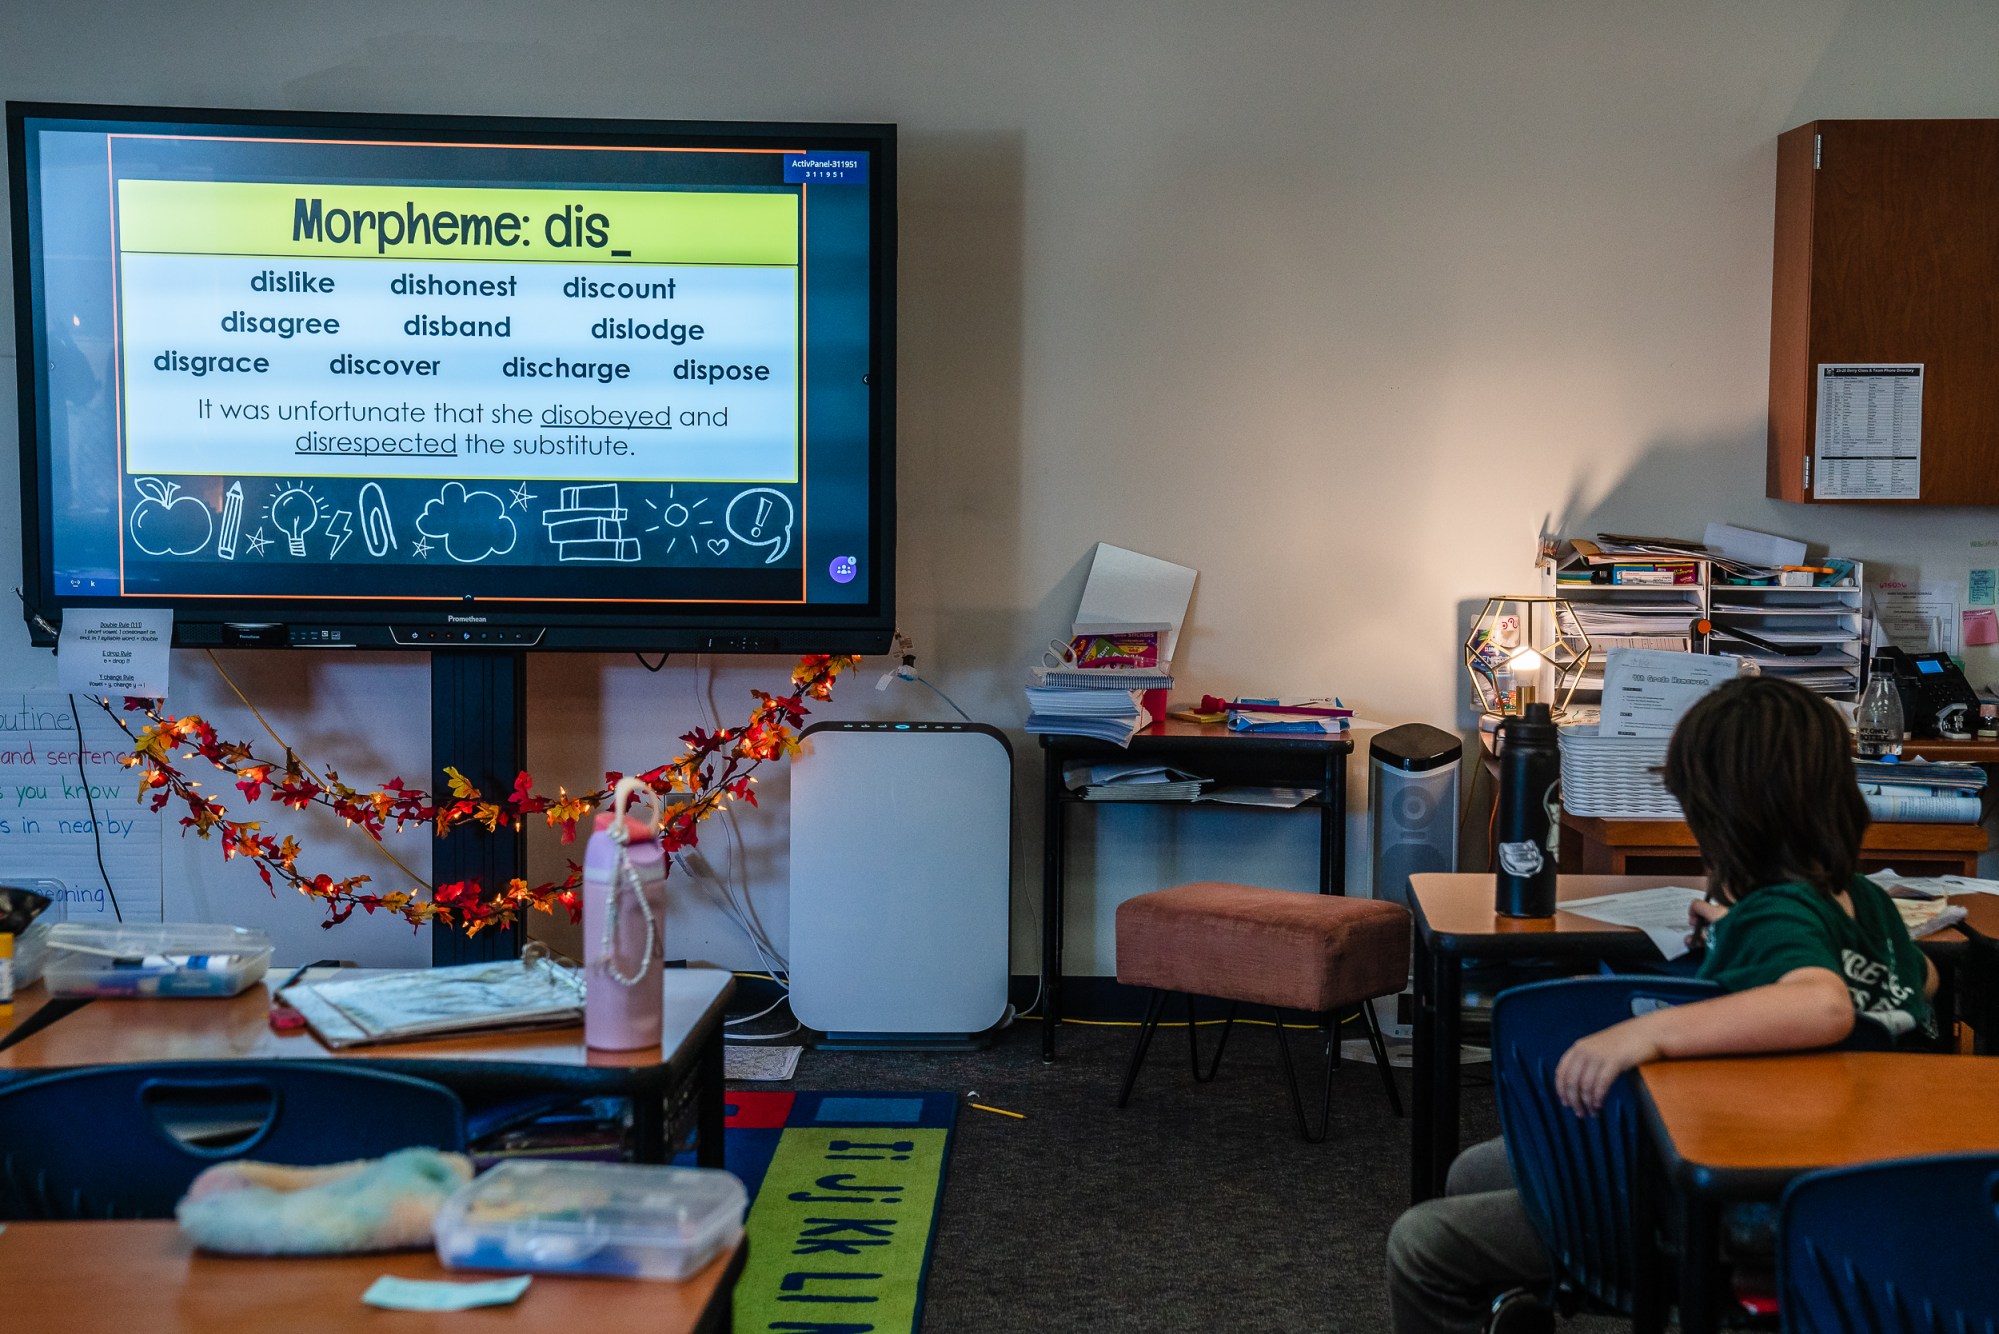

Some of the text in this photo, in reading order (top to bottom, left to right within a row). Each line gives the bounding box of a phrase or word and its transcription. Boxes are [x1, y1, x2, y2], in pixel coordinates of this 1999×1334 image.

[791, 159, 858, 169] ActivPanel-311951
[293, 198, 631, 257] Morpheme: dis_
[251, 270, 676, 299] dislike dishonest discount
[221, 311, 704, 345] disagree disband dislodge
[154, 350, 770, 386] disgrace discover discharge dispose
[199, 398, 728, 430] It was unfortunate that she disobeyed and
[295, 431, 635, 457] disrespected the substitute.
[448, 614, 487, 623] Promethean
[1, 740, 36, 764] and
[16, 786, 47, 807] you
[62, 775, 120, 799] know
[22, 816, 40, 833] in
